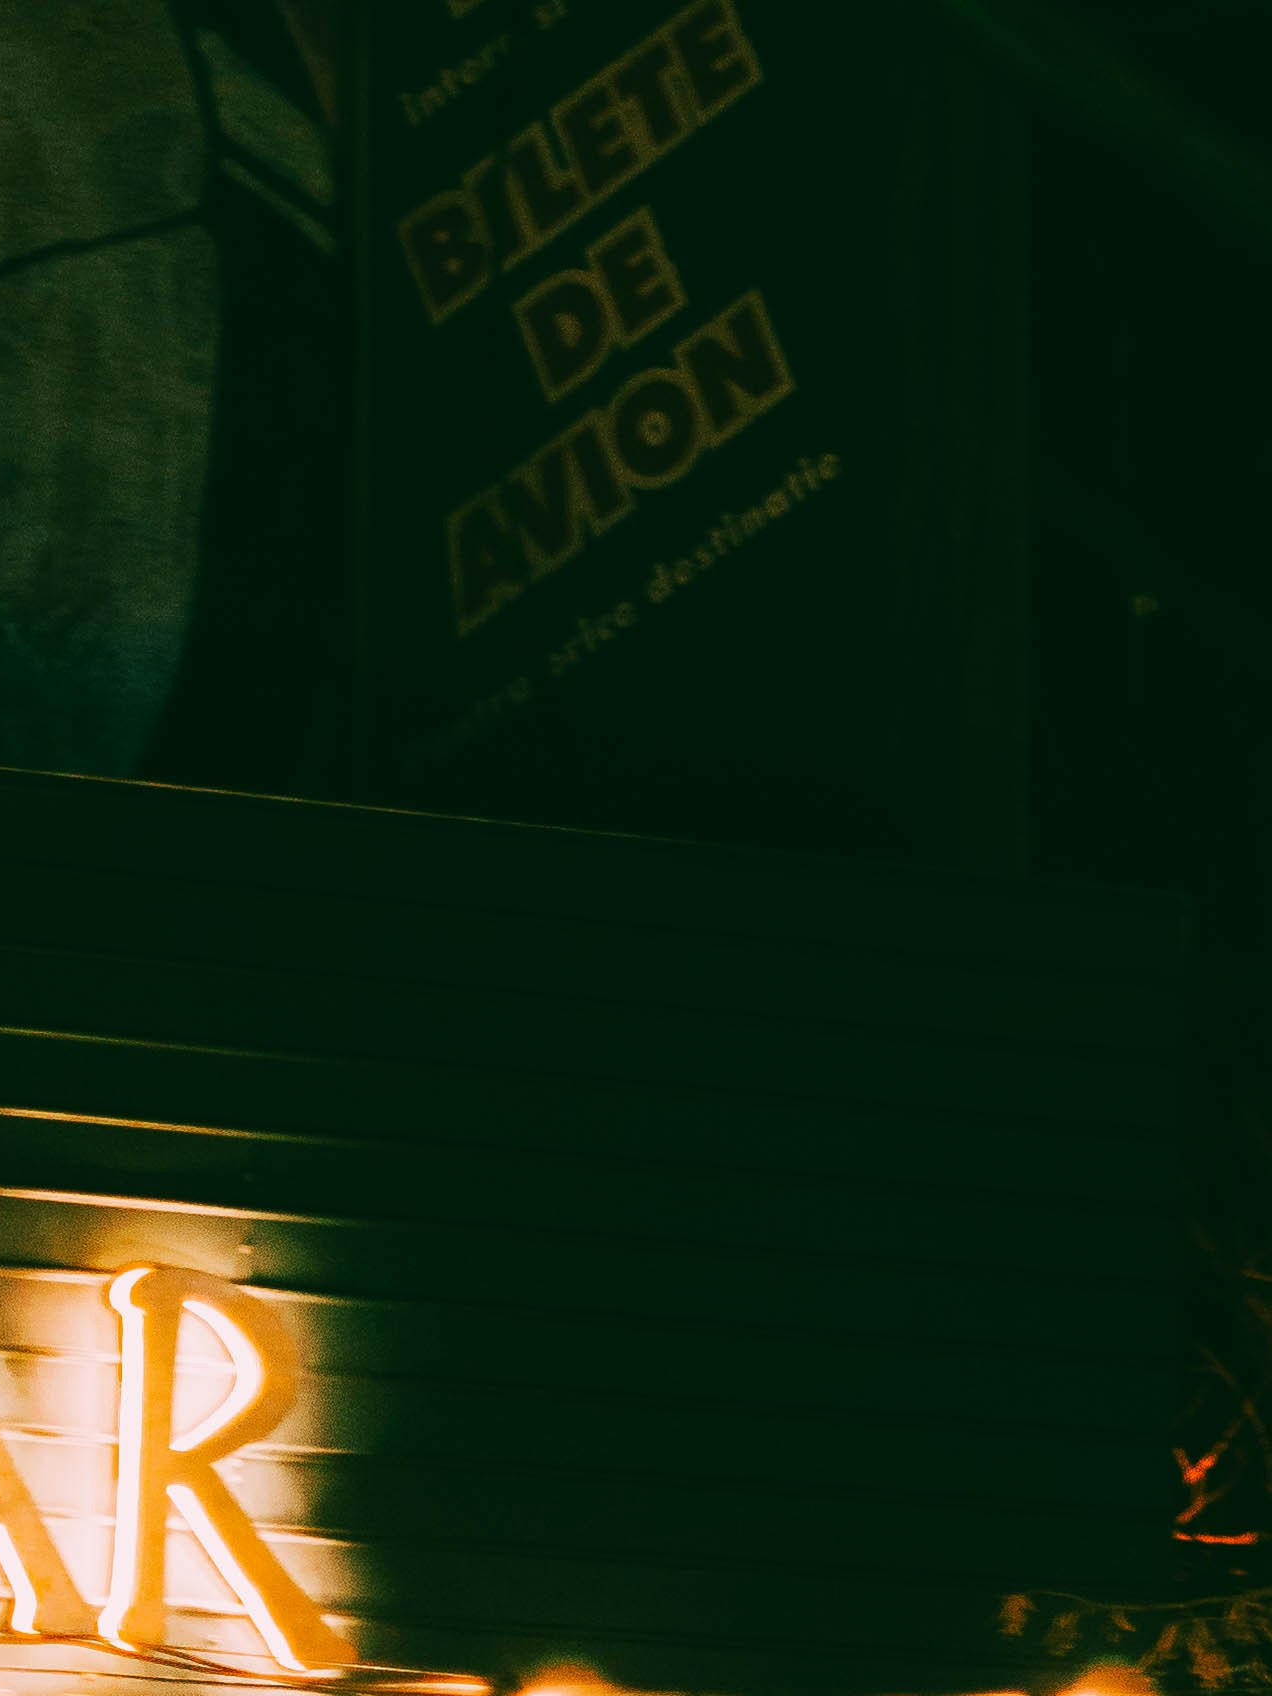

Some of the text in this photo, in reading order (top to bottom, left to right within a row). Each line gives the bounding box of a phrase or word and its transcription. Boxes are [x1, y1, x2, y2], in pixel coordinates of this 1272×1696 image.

[395, 0, 765, 326] BILETE
[511, 204, 690, 405] DE
[444, 286, 798, 640] AVION
